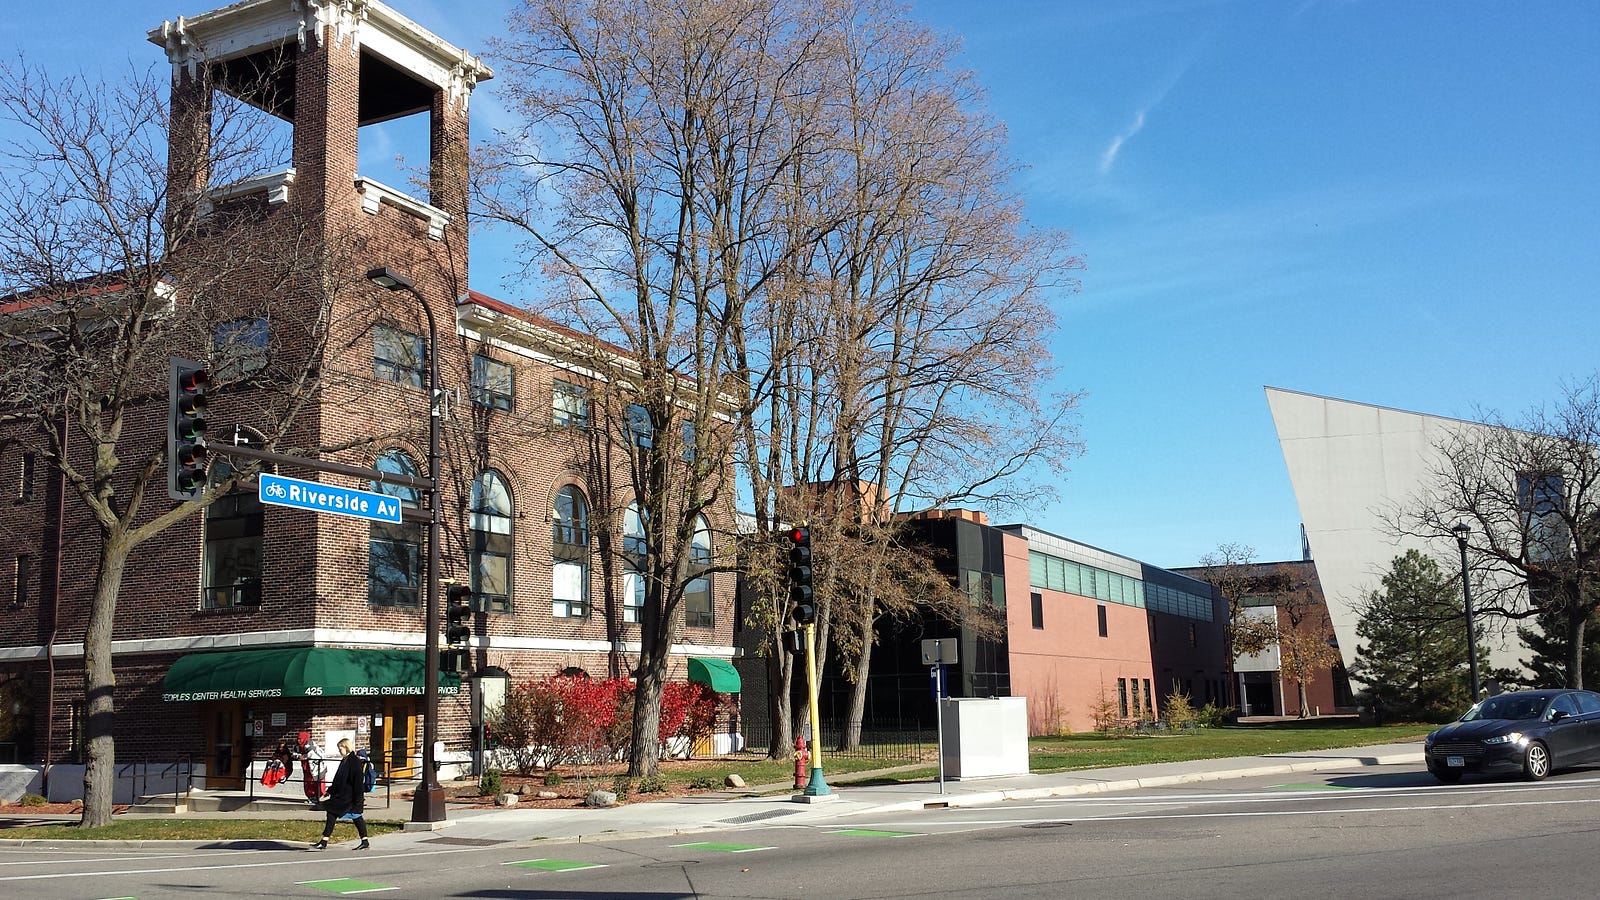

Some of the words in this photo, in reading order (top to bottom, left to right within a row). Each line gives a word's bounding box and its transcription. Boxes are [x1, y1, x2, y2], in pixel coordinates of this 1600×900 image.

[289, 484, 369, 512] Riverside
[377, 500, 397, 517] Av
[192, 691, 219, 701] CENTER
[220, 690, 247, 699] HEALTH
[247, 688, 282, 698] SERVICES
[305, 686, 323, 696] 425
[349, 686, 379, 695] PEOPLE'S
[381, 686, 405, 695] CENTER
[406, 686, 425, 695] HEALT
[437, 686, 458, 694] RVICES
